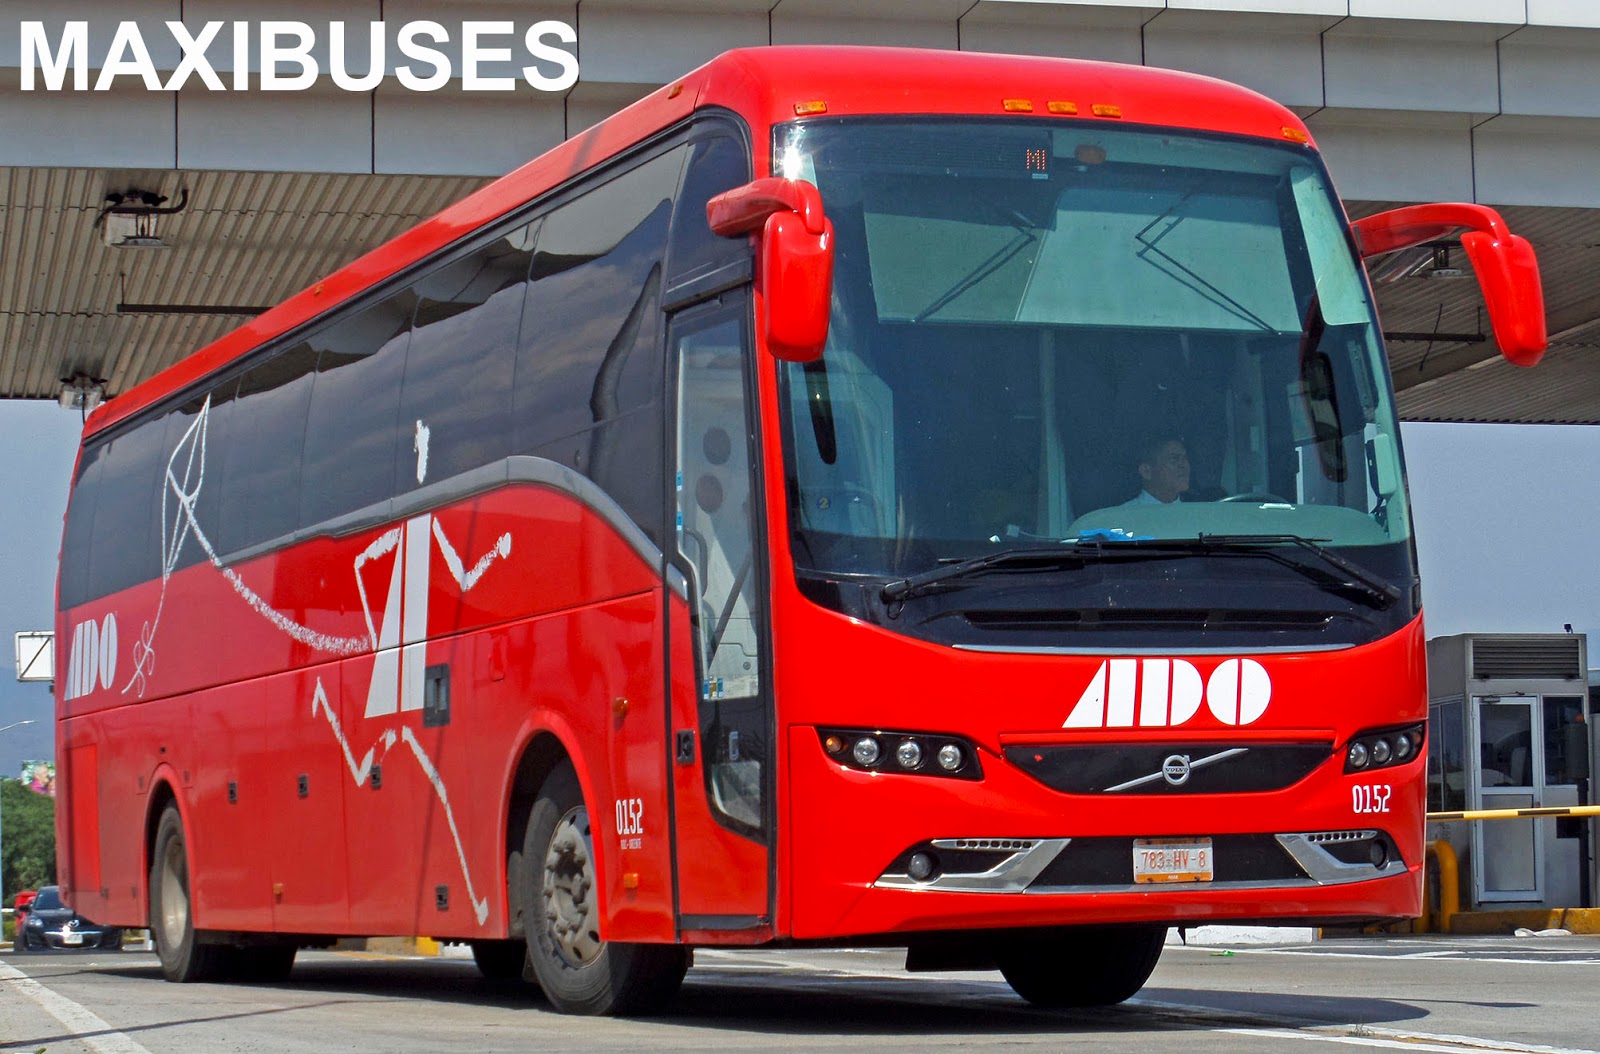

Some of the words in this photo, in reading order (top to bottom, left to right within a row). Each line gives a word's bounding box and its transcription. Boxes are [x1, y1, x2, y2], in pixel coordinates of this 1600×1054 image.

[64, 612, 118, 701] ADO
[1061, 658, 1272, 728] ADO
[615, 798, 643, 835] 0152
[1352, 784, 1391, 813] 0152
